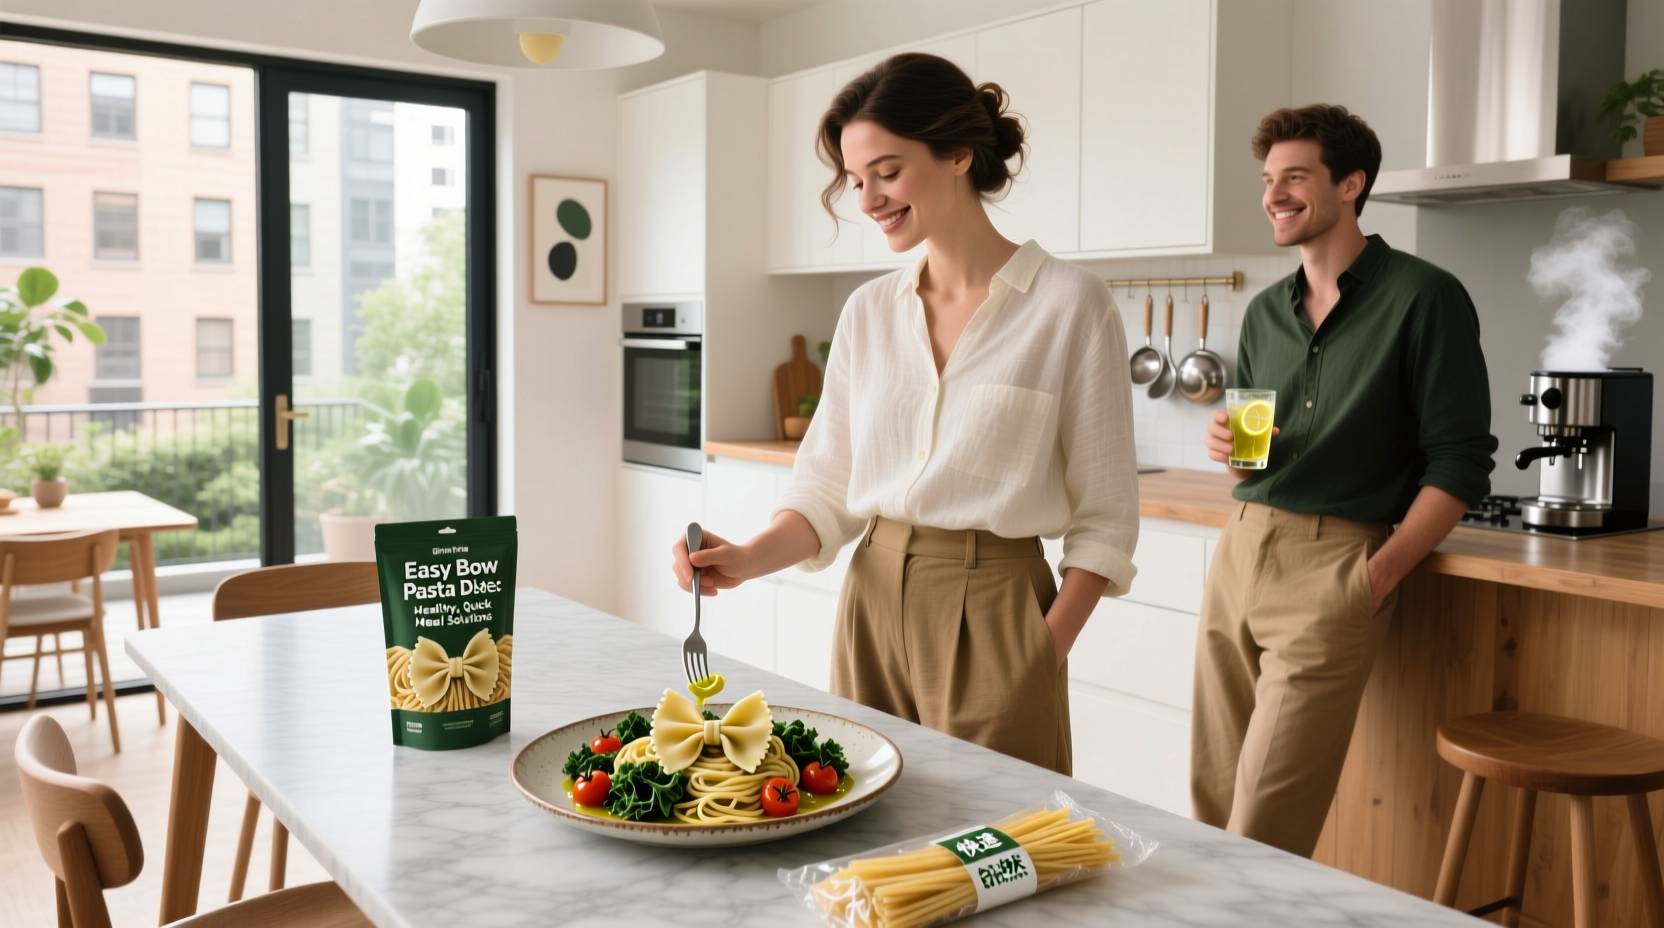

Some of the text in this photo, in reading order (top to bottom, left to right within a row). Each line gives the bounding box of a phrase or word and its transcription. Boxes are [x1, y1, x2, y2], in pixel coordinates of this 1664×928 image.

[404, 558, 499, 581] Easy Bow
[403, 581, 456, 601] Pasta
